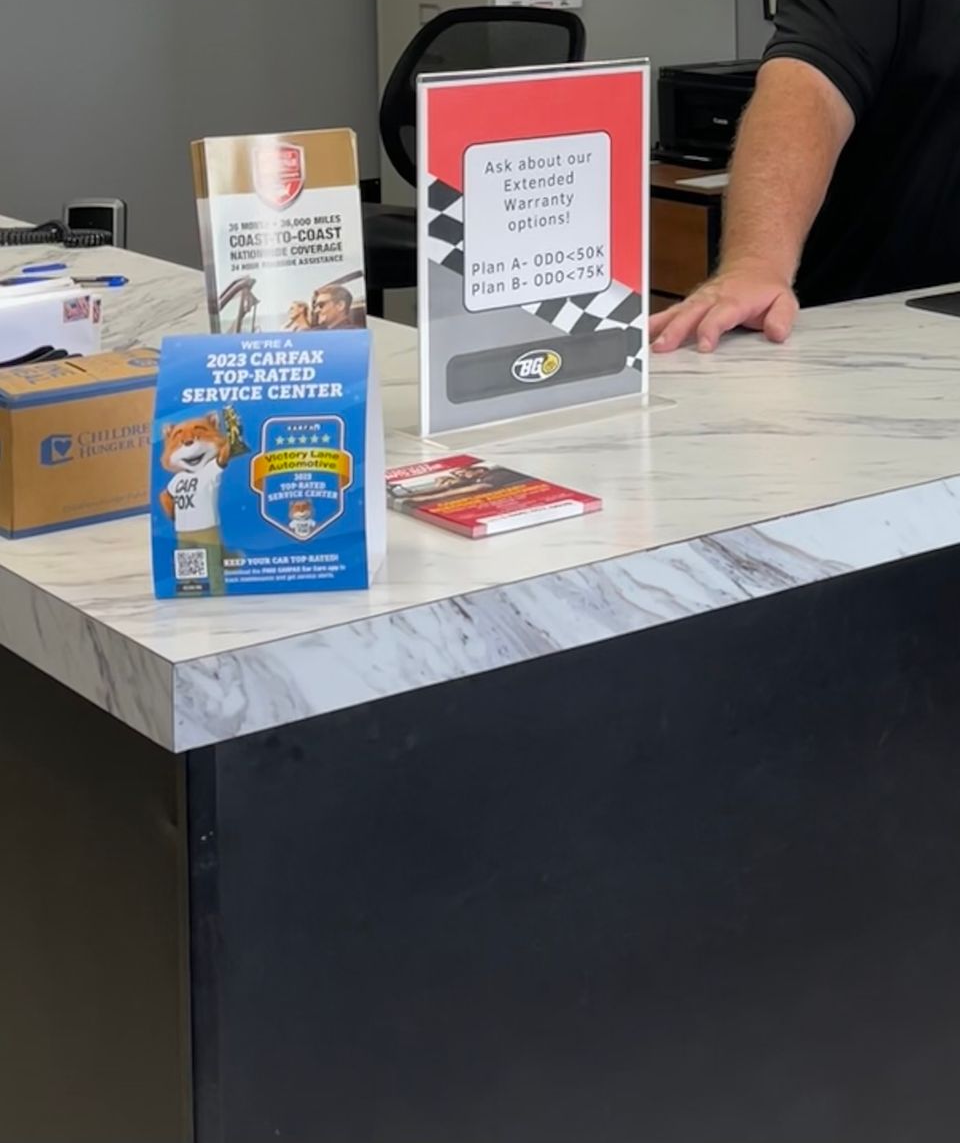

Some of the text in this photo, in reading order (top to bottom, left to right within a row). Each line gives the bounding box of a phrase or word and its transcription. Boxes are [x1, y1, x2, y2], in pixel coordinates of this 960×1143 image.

[484, 152, 592, 175] Ask about our
[503, 171, 575, 193] Extended
[503, 192, 575, 212] Warranty
[280, 217, 312, 229] 36,000
[313, 214, 342, 225] MILES
[507, 211, 571, 233] options!
[290, 241, 343, 256] COVERAGE
[298, 254, 344, 266] ASSISTANCE
[471, 244, 605, 276] Plan A- ODO<50K
[471, 264, 605, 297] Plan B- ODO<75K
[240, 338, 294, 351] WE'RE A
[206, 350, 325, 369] 2023 CARFAX
[516, 357, 545, 377] BG
[211, 367, 316, 386] TOP-RATED
[181, 383, 344, 404] SERVICE CENTER
[80, 438, 135, 459] HUNGER
[264, 449, 340, 463] Victory Lane
[268, 460, 337, 472] Automotive
[175, 477, 199, 493] CAR
[280, 481, 326, 491] TOP-RATED
[174, 493, 196, 510] FOX
[267, 489, 338, 502] SERVICE CENTER
[223, 558, 246, 568] KEEP
[247, 556, 271, 566] YOUR
[271, 556, 289, 565] CAR
